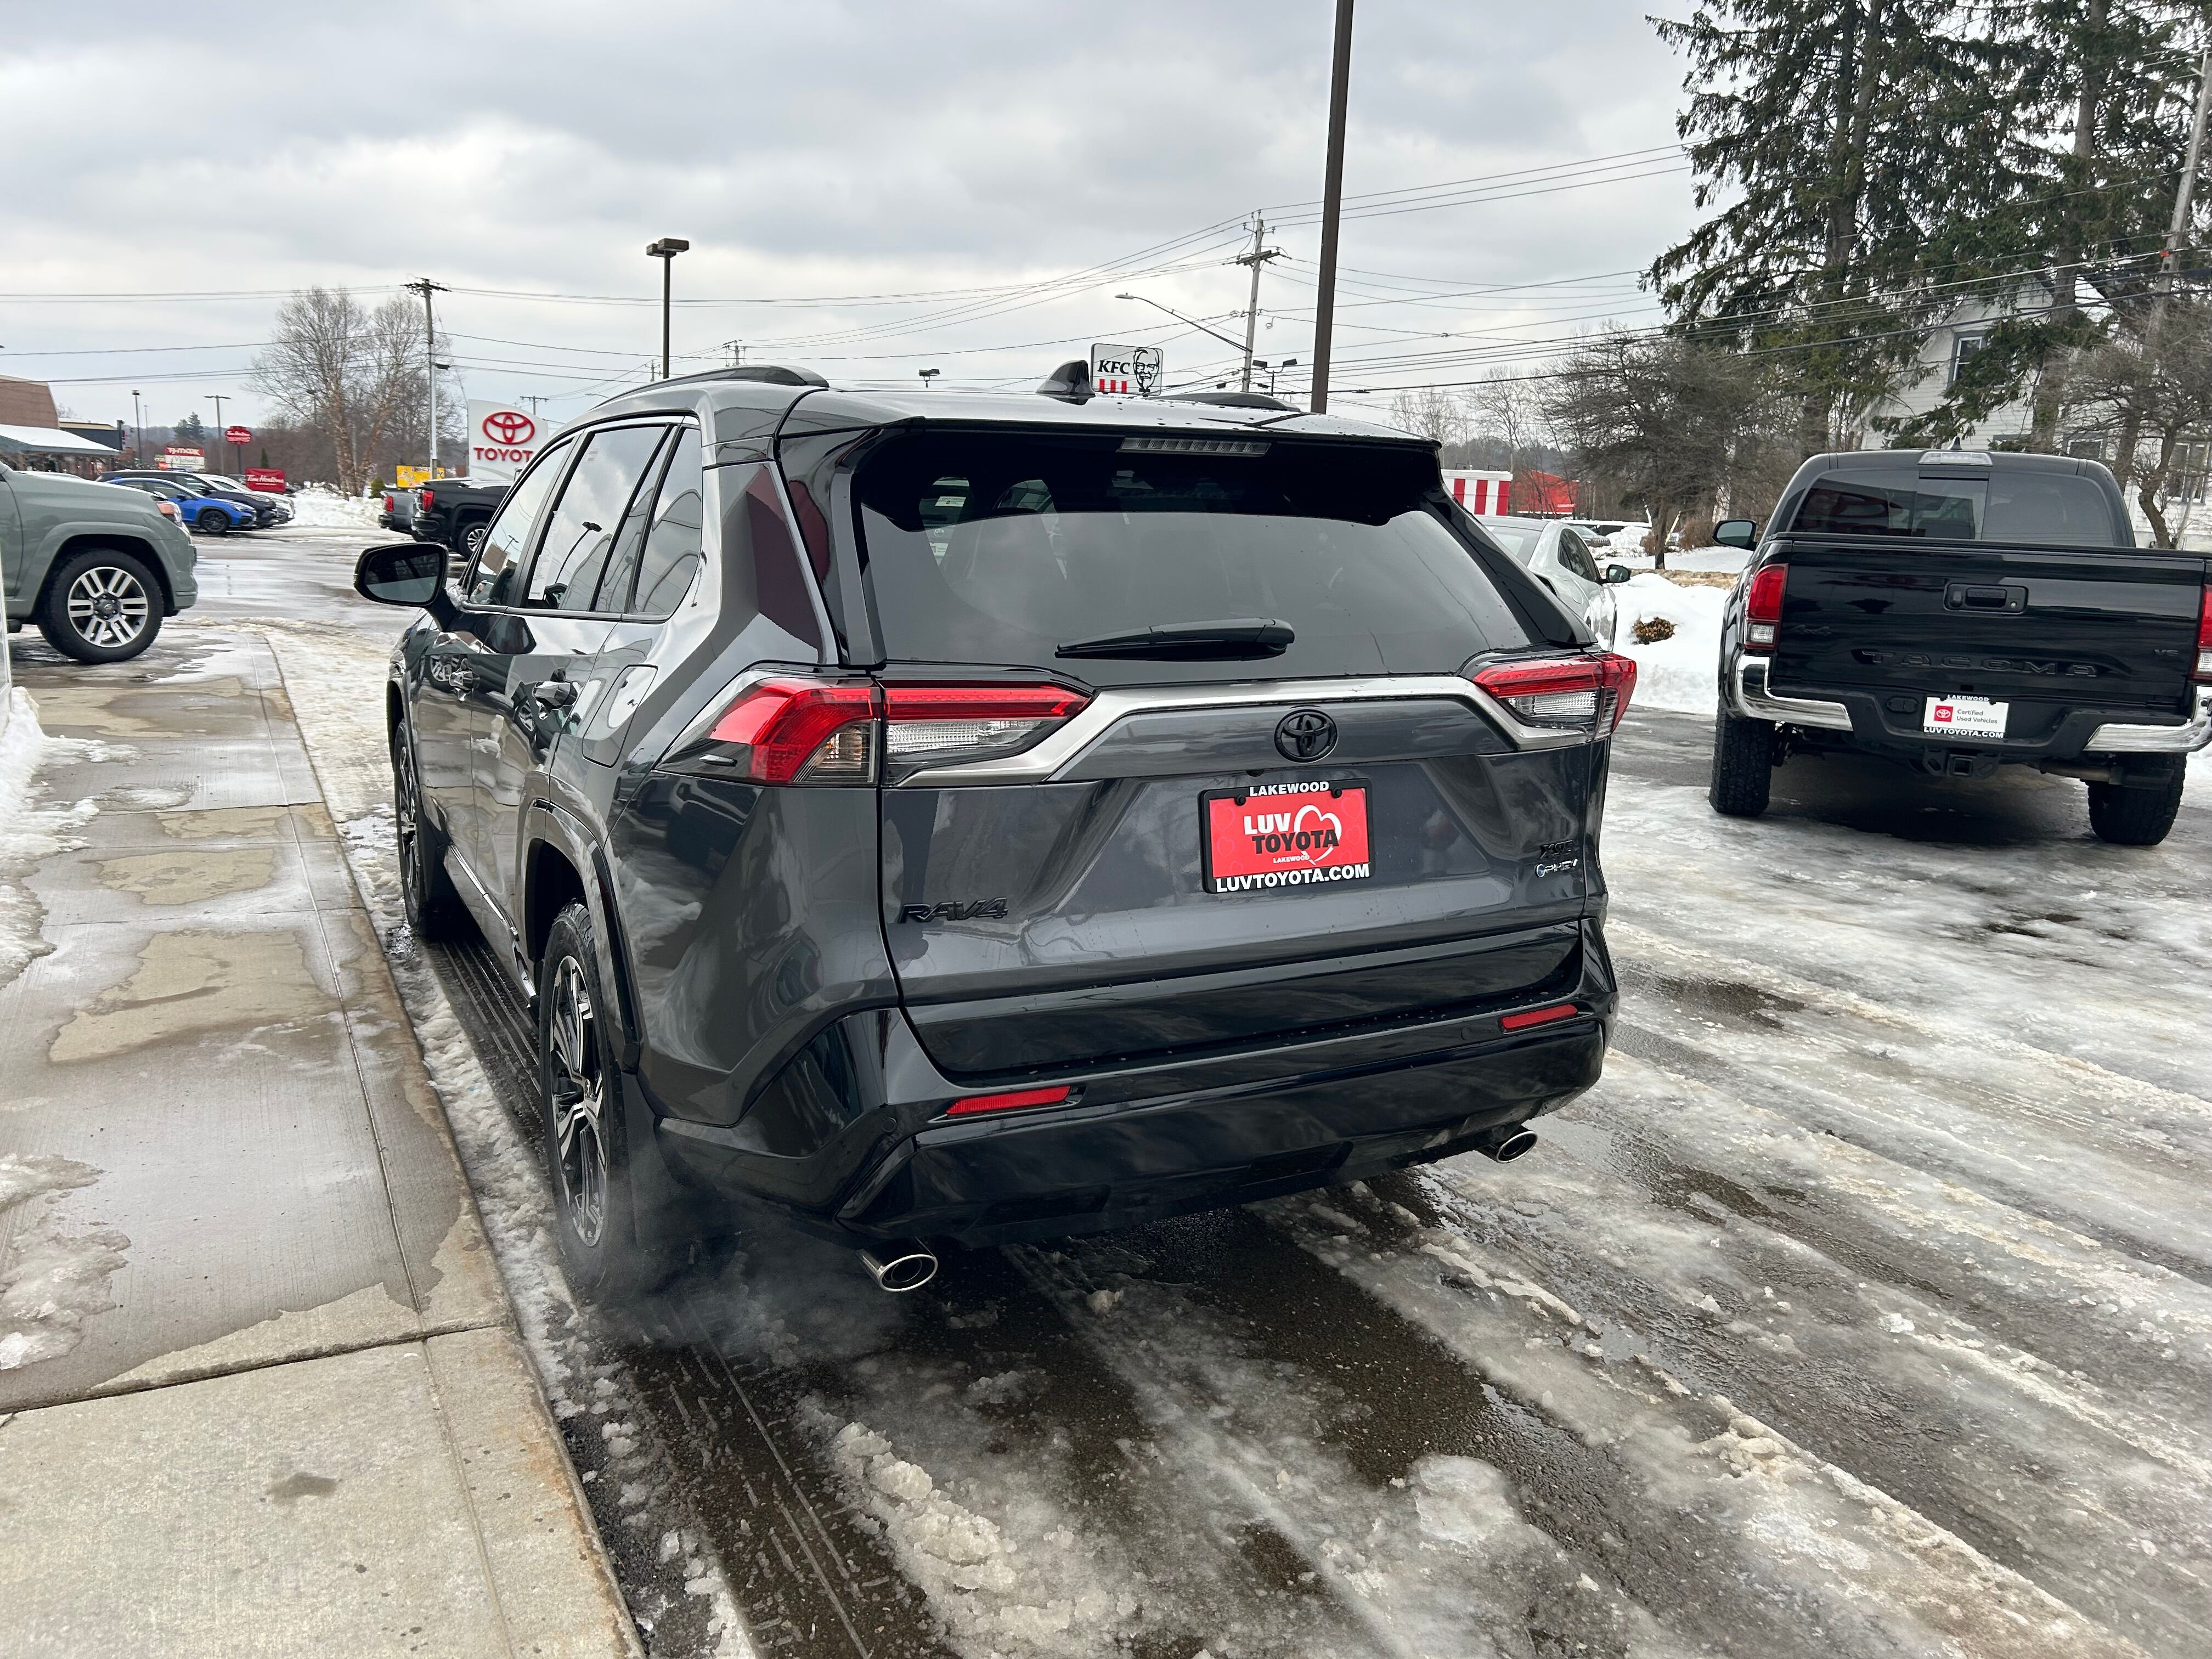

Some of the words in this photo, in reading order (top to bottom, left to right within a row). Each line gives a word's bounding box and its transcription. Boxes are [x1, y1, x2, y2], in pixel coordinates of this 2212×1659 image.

[1097, 360, 1130, 374] KFC
[473, 447, 533, 462] TOYOT
[1861, 650, 2097, 677] TACOMA
[1923, 726, 2004, 738] LUVTOYOTA.COM
[1249, 781, 1329, 797] LAKEWOOD
[1243, 812, 1291, 835] LUV
[1252, 829, 1339, 854] TOYOTA
[1273, 855, 1310, 864] LAKEWOOD
[1216, 864, 1370, 893] LUVTOYOTA.COM
[897, 896, 1009, 923] RAV4
